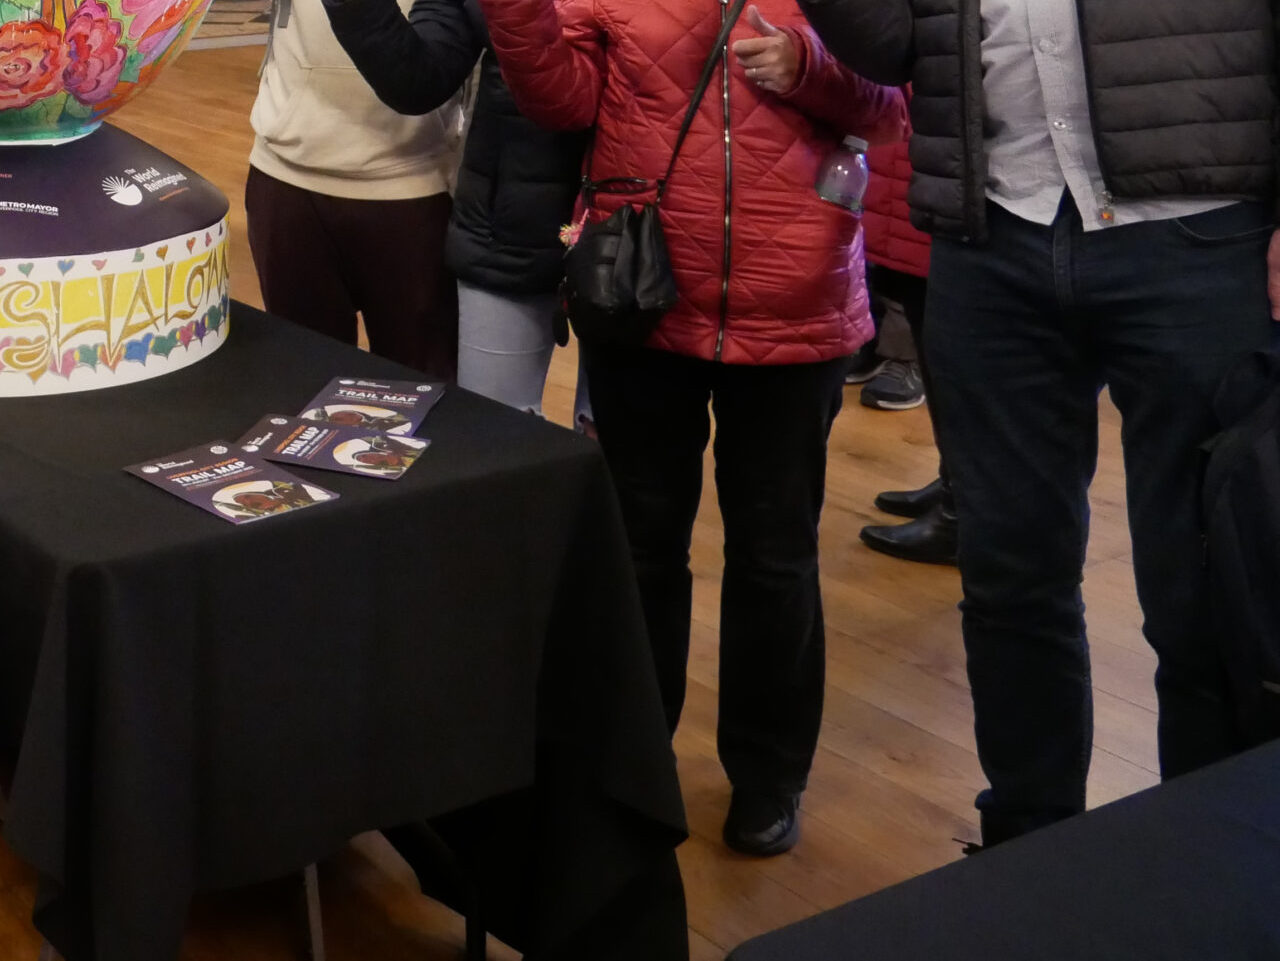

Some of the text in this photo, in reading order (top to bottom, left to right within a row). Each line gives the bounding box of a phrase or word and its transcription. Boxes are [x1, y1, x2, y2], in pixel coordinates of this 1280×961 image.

[131, 166, 161, 184] World
[142, 171, 188, 193] Reimagined
[338, 389, 378, 399] TRAIL
[382, 394, 419, 402] MAP
[281, 439, 309, 455] TRAIL
[171, 471, 216, 484] TRAIL
[213, 460, 246, 475] MAP
